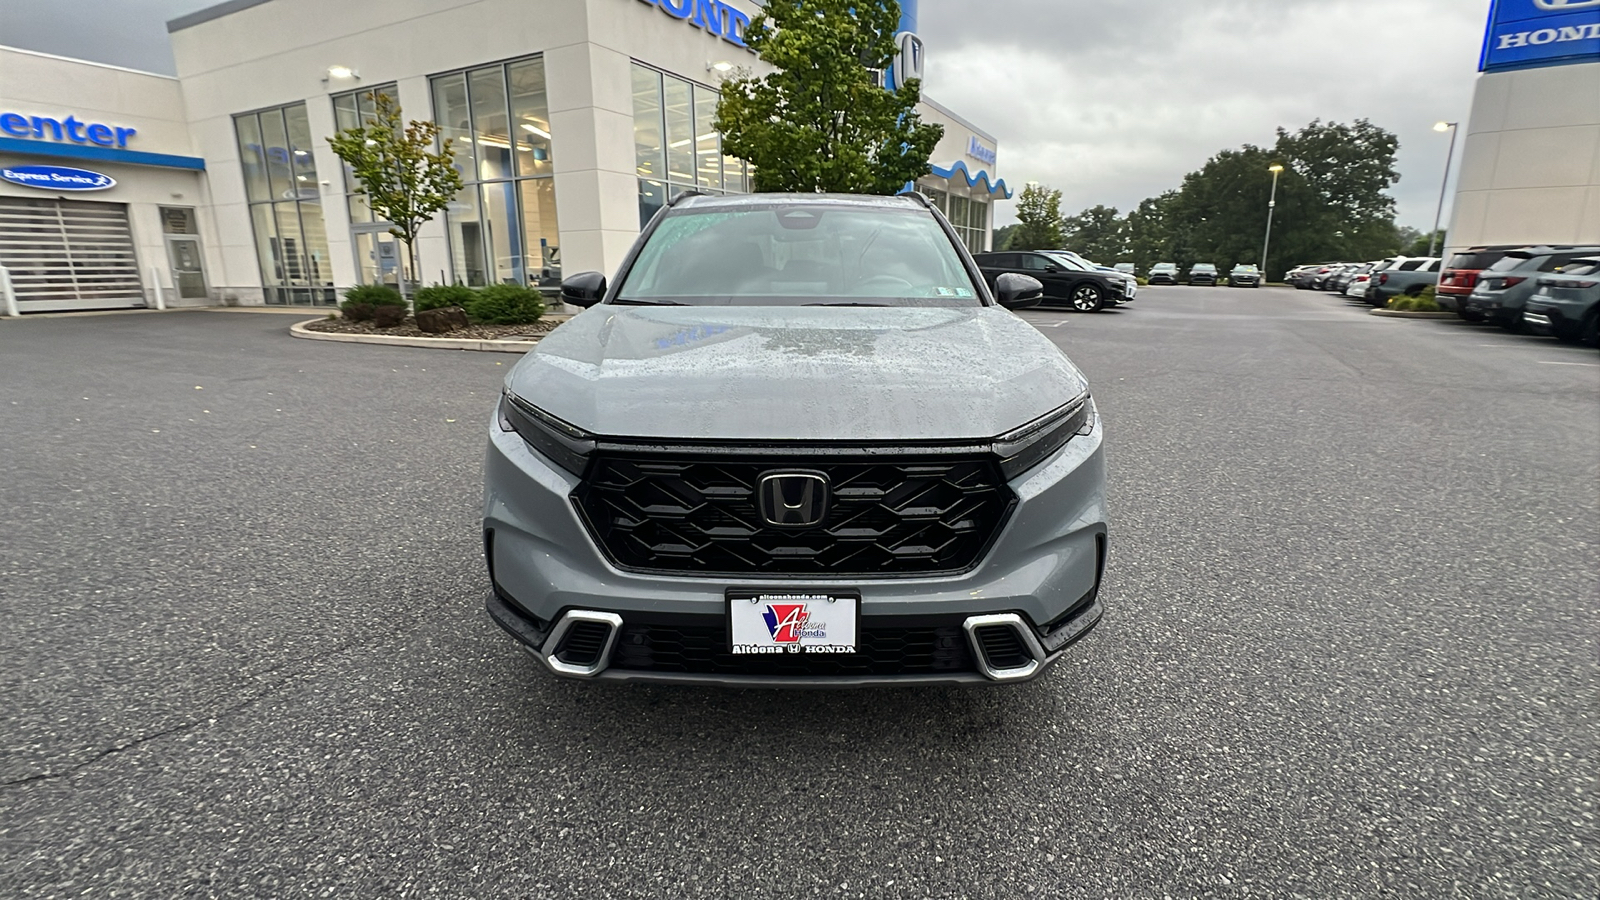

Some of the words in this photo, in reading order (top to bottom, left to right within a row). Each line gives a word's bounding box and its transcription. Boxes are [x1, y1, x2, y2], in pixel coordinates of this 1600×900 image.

[0, 112, 136, 147] enter
[3, 169, 50, 182] Express
[794, 629, 826, 638] Honda
[732, 645, 784, 654] Altoona
[805, 645, 856, 653] HONDA
